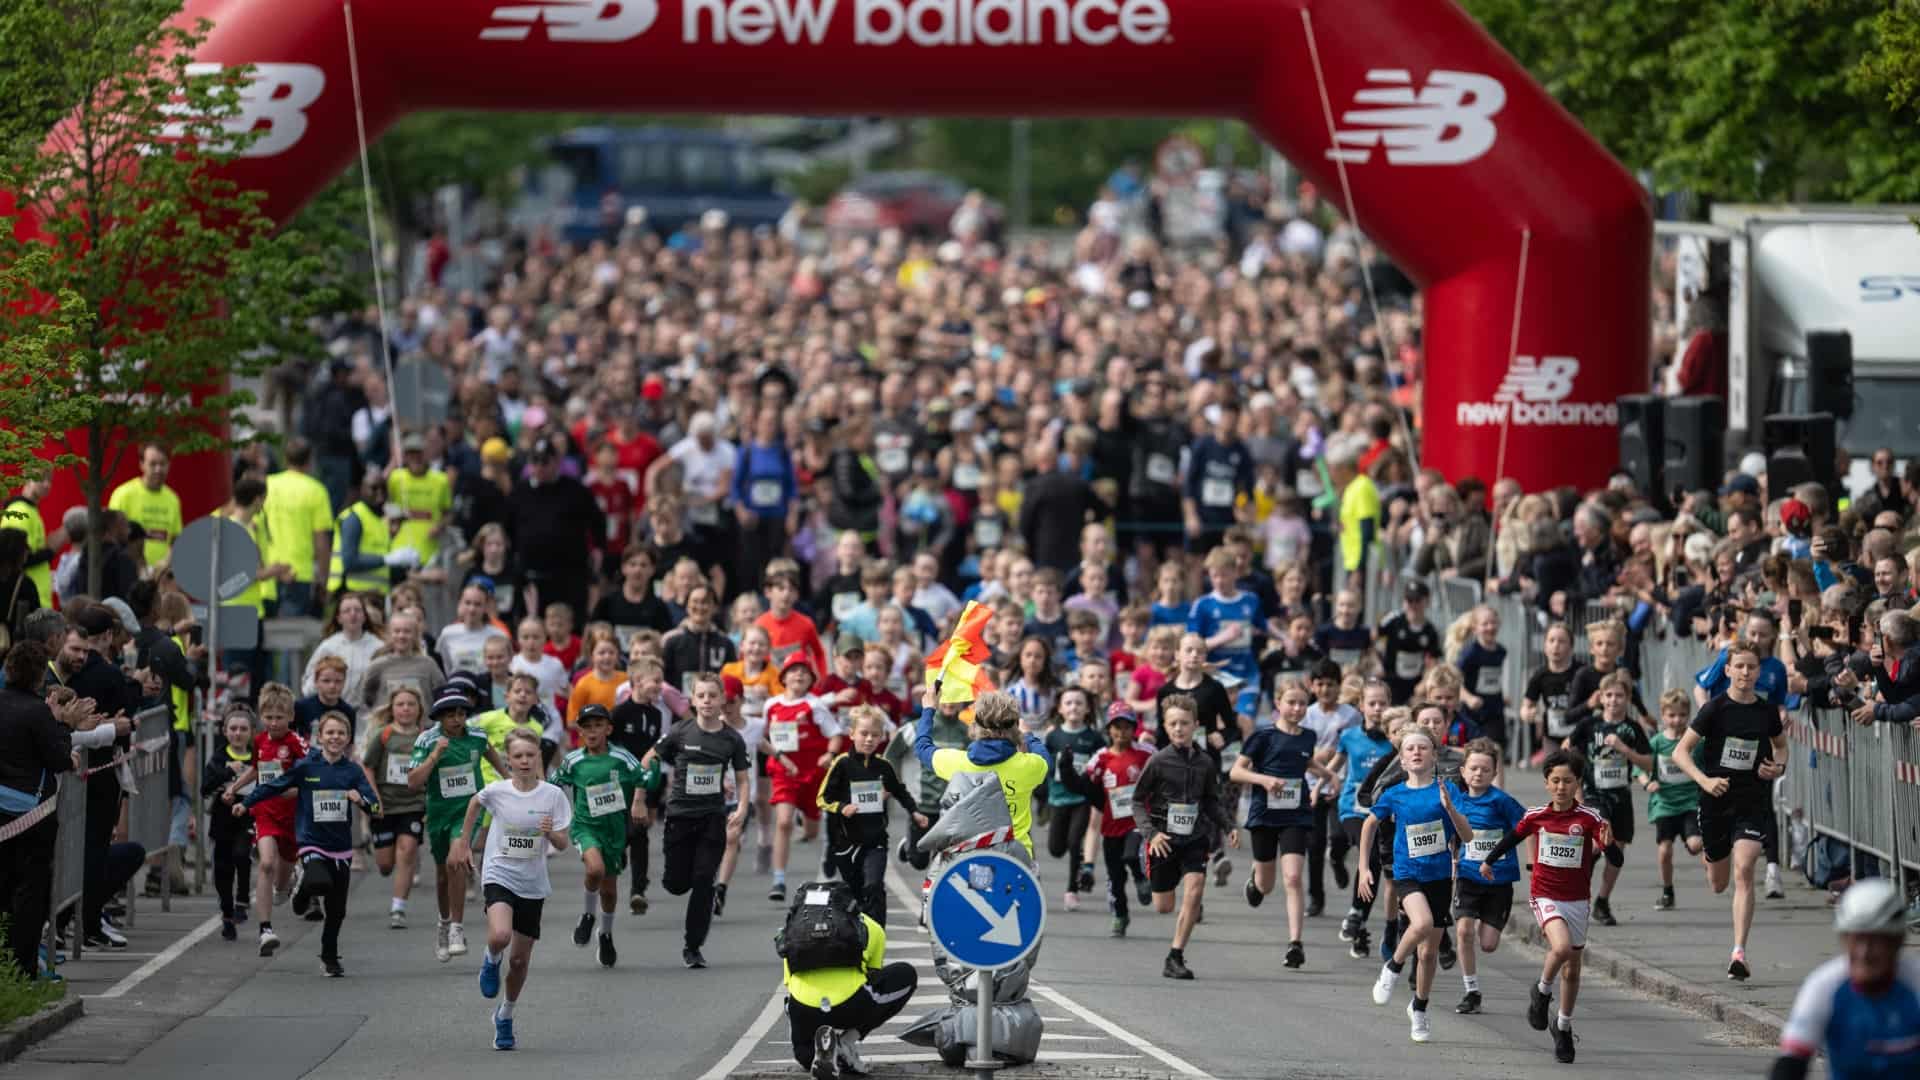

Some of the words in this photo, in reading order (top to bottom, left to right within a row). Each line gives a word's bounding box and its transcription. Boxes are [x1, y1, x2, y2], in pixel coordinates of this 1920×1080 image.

[682, 0, 836, 46] new
[854, 0, 1170, 46] balance
[1325, 70, 1506, 165] NB
[1493, 356, 1579, 402] NB
[1457, 402, 1505, 425] new
[507, 837, 535, 849] 13530
[1412, 833, 1438, 847] 13997
[1549, 846, 1577, 859] 13252
